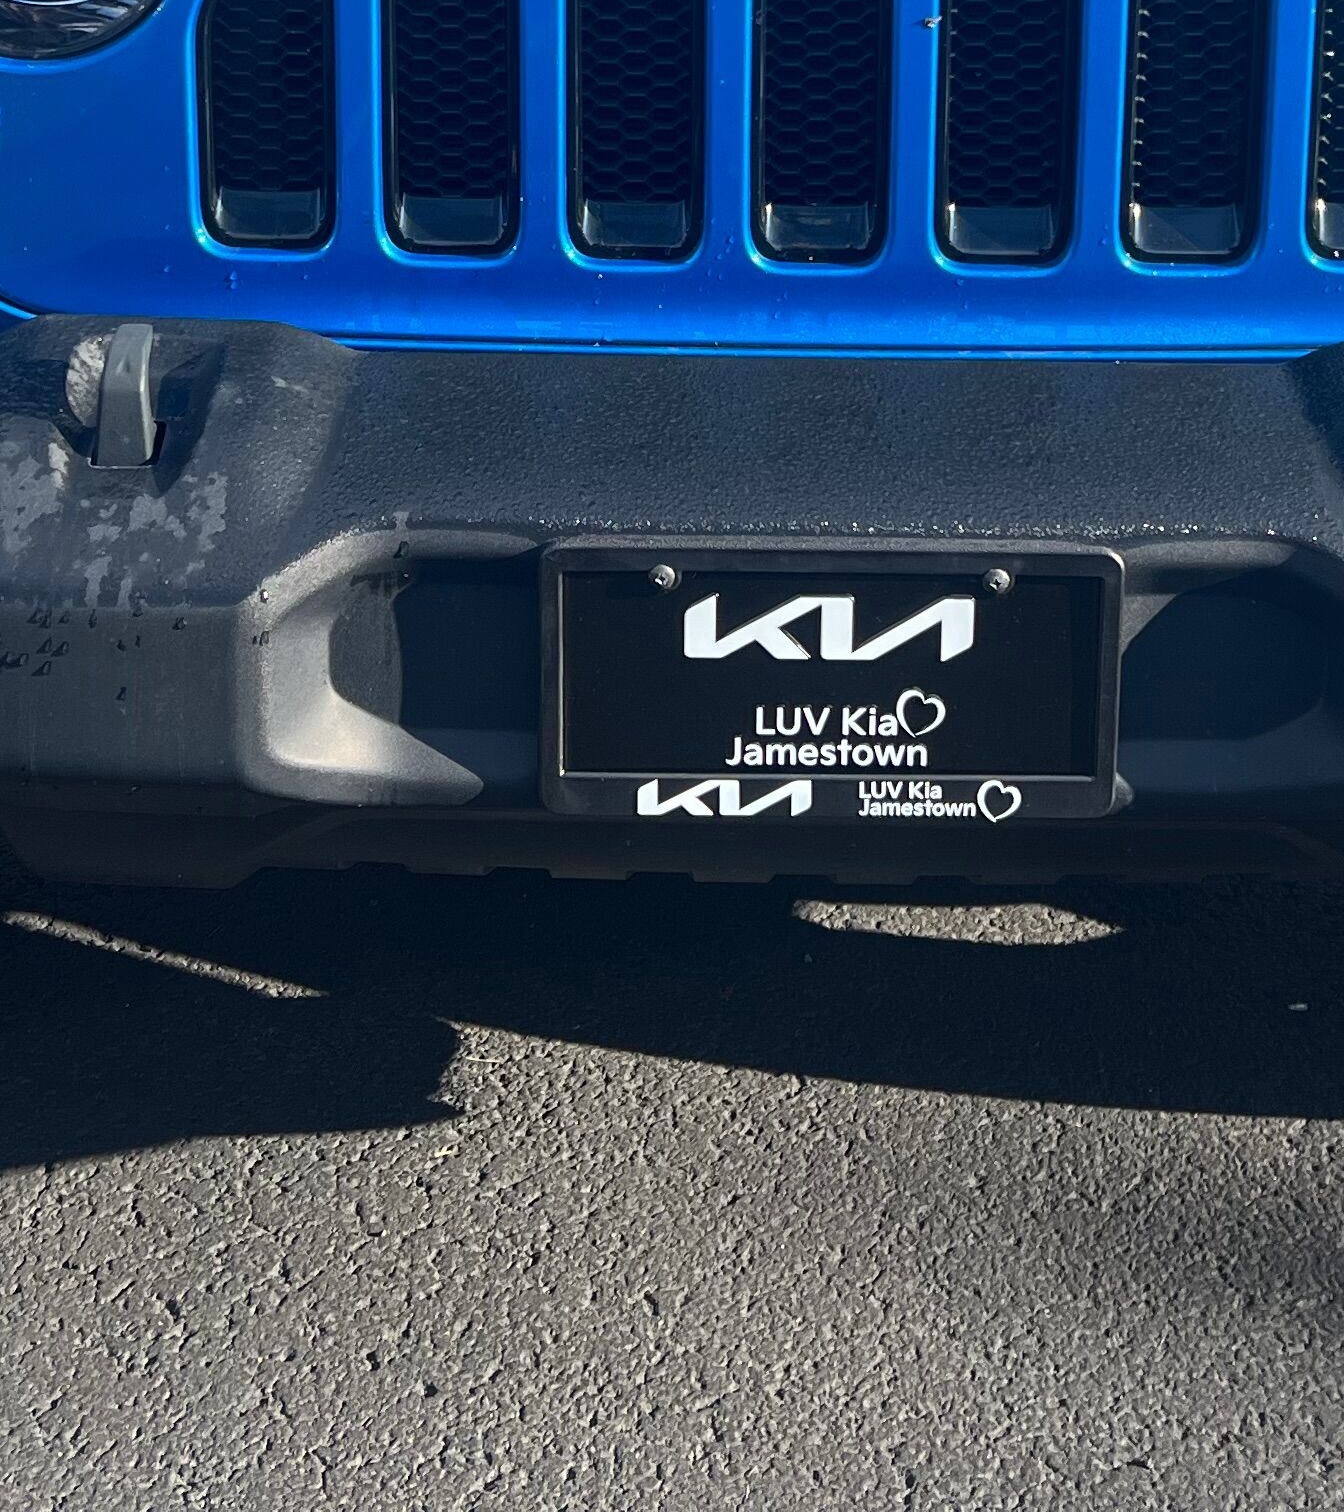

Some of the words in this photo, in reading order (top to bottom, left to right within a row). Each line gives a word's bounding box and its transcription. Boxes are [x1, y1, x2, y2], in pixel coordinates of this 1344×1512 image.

[684, 594, 975, 662] KIA
[756, 707, 830, 736] LUV
[842, 706, 899, 736] Kia
[725, 736, 928, 767] Jamestown
[637, 778, 813, 817] KIA
[859, 780, 903, 799] LUV
[908, 780, 942, 799] Kia
[859, 798, 976, 817] Jamestown
